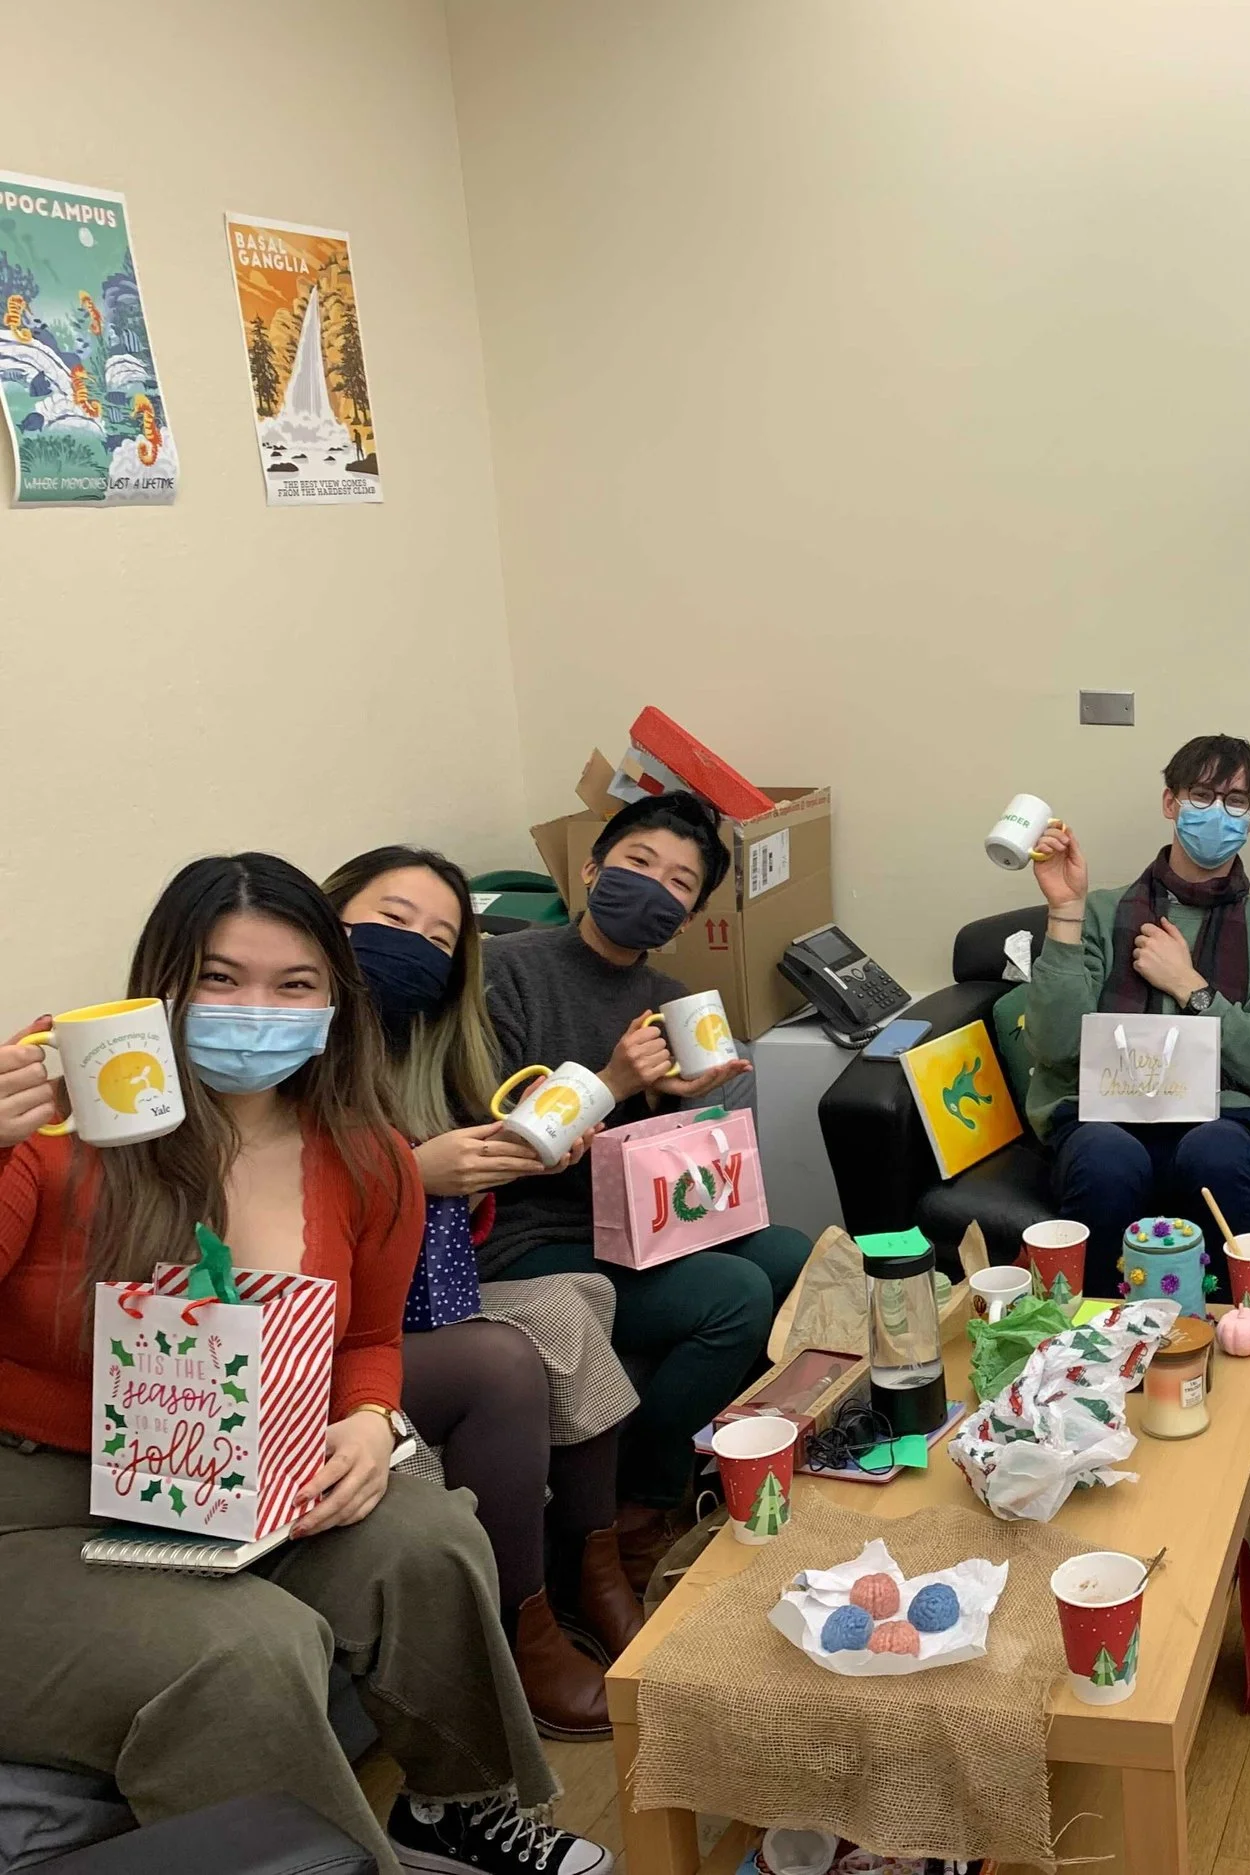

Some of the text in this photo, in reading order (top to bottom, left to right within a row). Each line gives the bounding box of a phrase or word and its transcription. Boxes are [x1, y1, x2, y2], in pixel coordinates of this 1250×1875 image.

[234, 231, 287, 254] BASAL
[238, 249, 310, 274] GANGLIA
[23, 476, 175, 490] WHERE MEMORIES LAST A LIFETIME
[278, 486, 376, 497] FROM THE HARDEST CLIMB
[283, 478, 367, 489] THE BEST VIEW COMES
[150, 1104, 171, 1117] Yale
[174, 1358, 207, 1380] THE
[122, 1380, 223, 1419] season
[135, 1415, 169, 1434] TO BE
[115, 1419, 234, 1507] jolly
